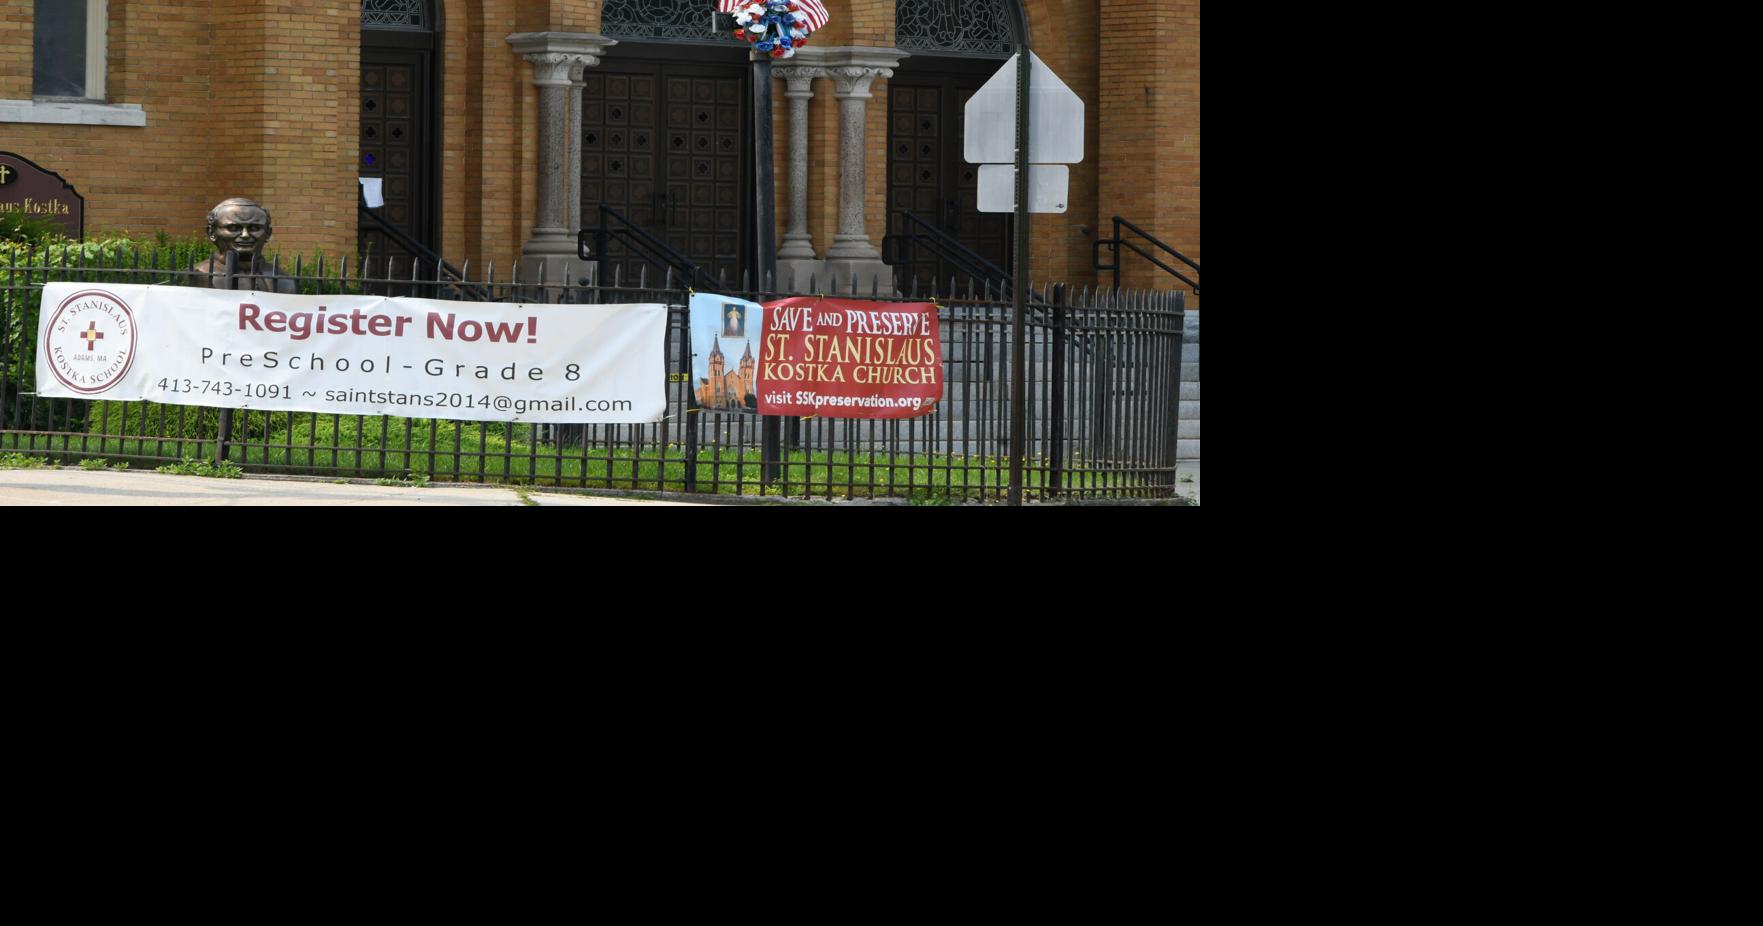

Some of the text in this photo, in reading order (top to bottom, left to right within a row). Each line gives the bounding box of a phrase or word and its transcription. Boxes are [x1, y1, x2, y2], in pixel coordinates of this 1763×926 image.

[24, 198, 69, 214] Kostka
[69, 300, 128, 336] STANISLAUS
[238, 303, 537, 344] Register Now!
[770, 306, 930, 336] SAVE AND PRESERVE
[54, 346, 86, 384] KOSTKA
[764, 333, 935, 366] ST. STANISLAUS
[564, 363, 581, 382] 8
[764, 362, 936, 384] KOSTKA CHURCH
[157, 377, 292, 400] 413-743-1091
[325, 387, 632, 414] saintstans2014@gmail.com
[765, 391, 793, 405] visit
[795, 391, 922, 411] SSKpreservation.org
